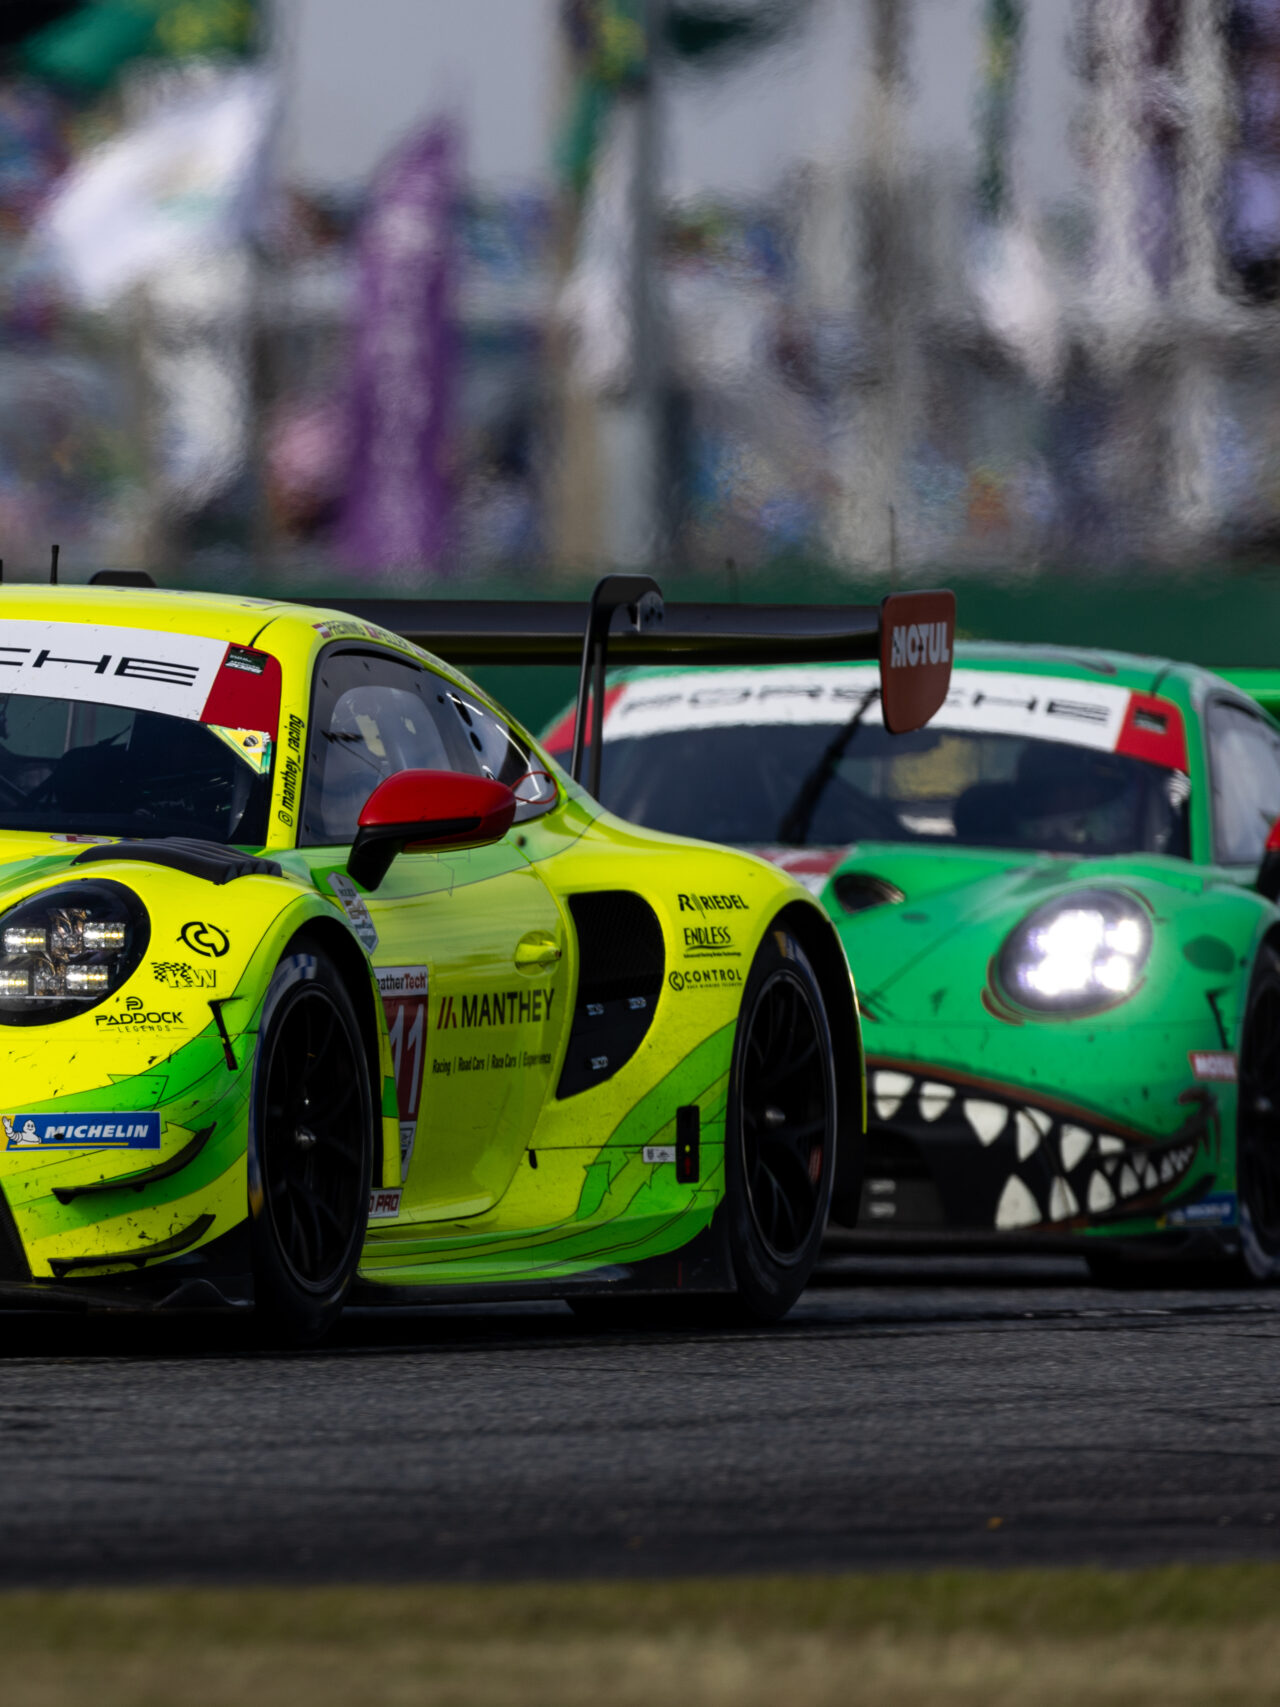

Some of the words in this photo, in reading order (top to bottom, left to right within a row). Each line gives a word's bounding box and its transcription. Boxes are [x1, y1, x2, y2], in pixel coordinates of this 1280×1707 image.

[891, 622, 950, 668] MOTUL
[619, 684, 1112, 726] PORSHE
[699, 894, 750, 910] RIEDEL
[683, 926, 732, 945] ENDLESS
[376, 971, 426, 990] eatherTech
[684, 968, 742, 983] CONTROL
[95, 1011, 184, 1026] PADDOCK
[461, 989, 555, 1029] MANTHEY
[118, 1025, 170, 1033] LEGENDS
[44, 1123, 149, 1139] MICHELIN
[376, 1194, 400, 1213] PRO
